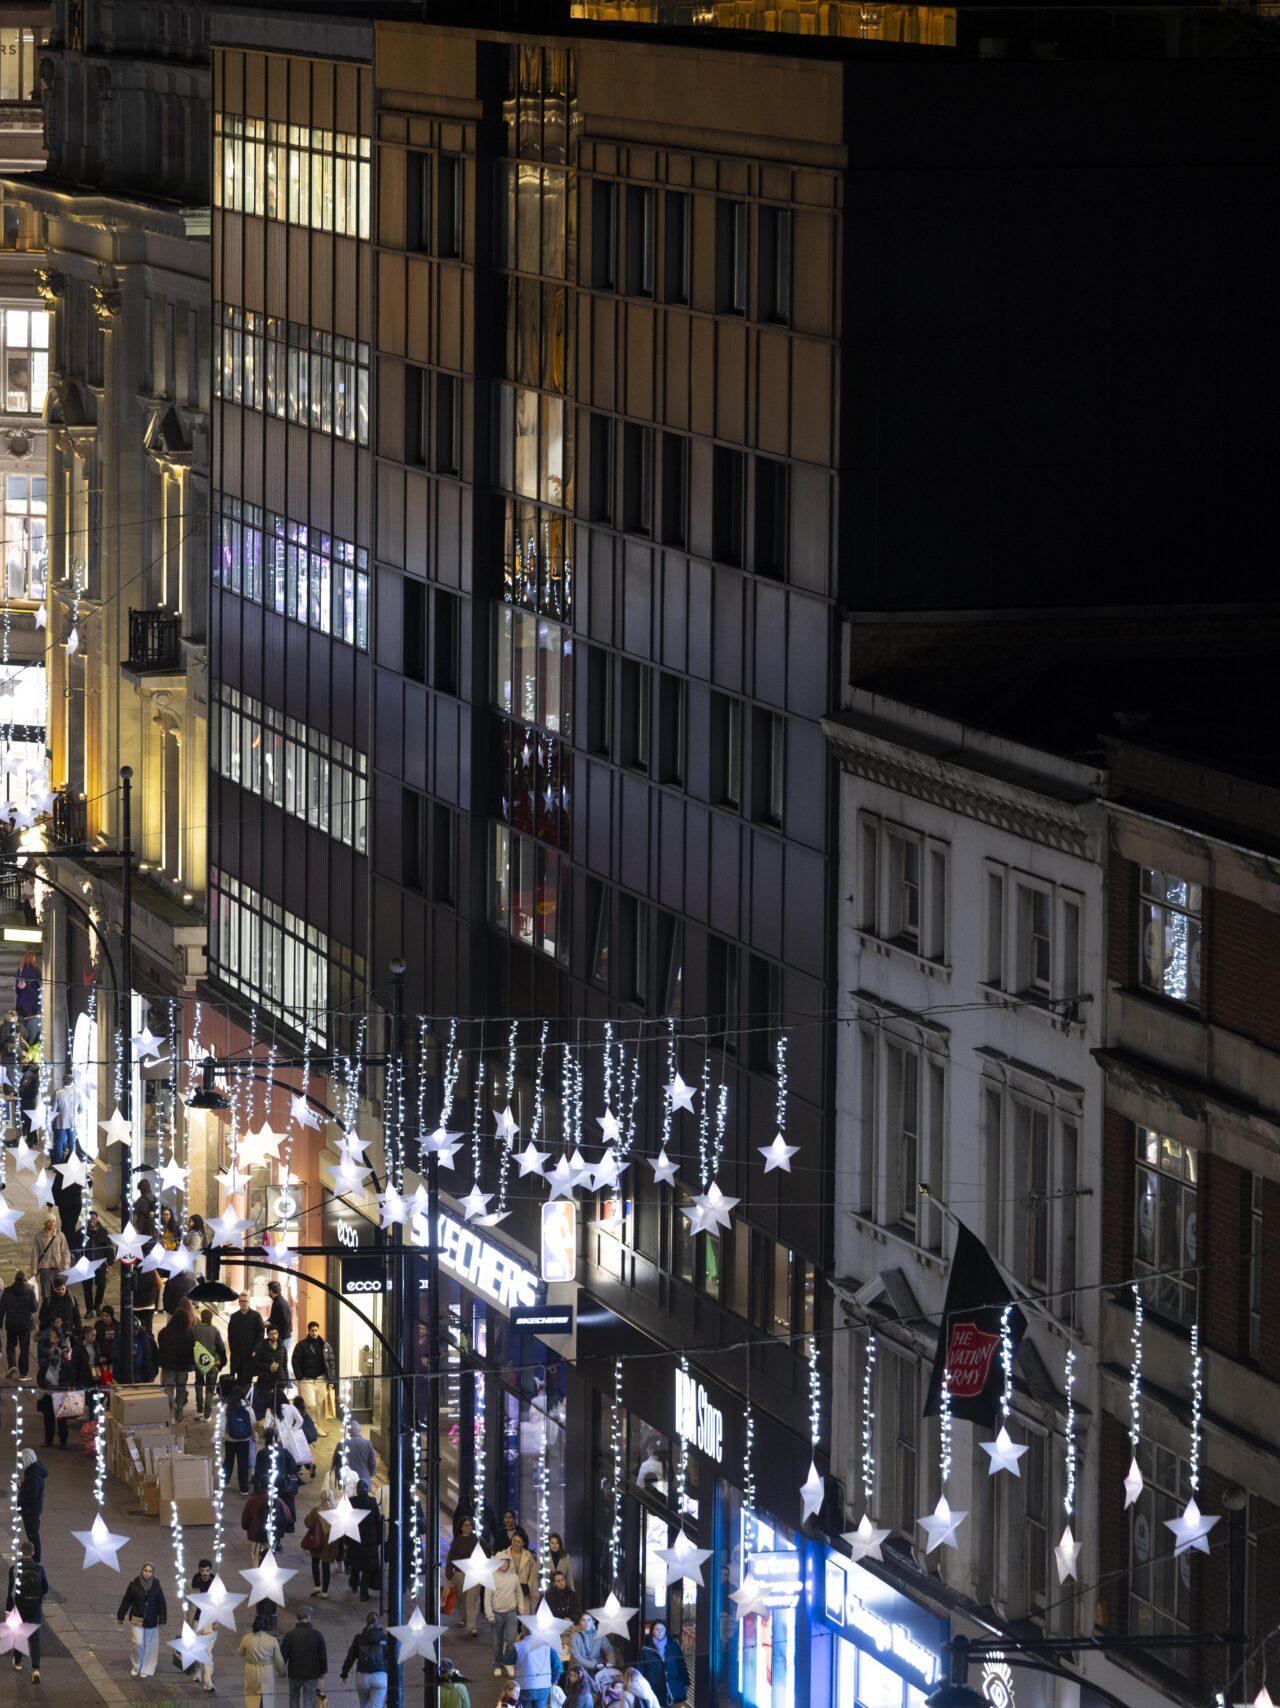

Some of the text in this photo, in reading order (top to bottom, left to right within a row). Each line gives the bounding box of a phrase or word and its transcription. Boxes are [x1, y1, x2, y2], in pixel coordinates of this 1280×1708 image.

[346, 1280, 382, 1292] ecco
[515, 1316, 570, 1325] SKECHERS
[697, 1384, 723, 1464] Store
